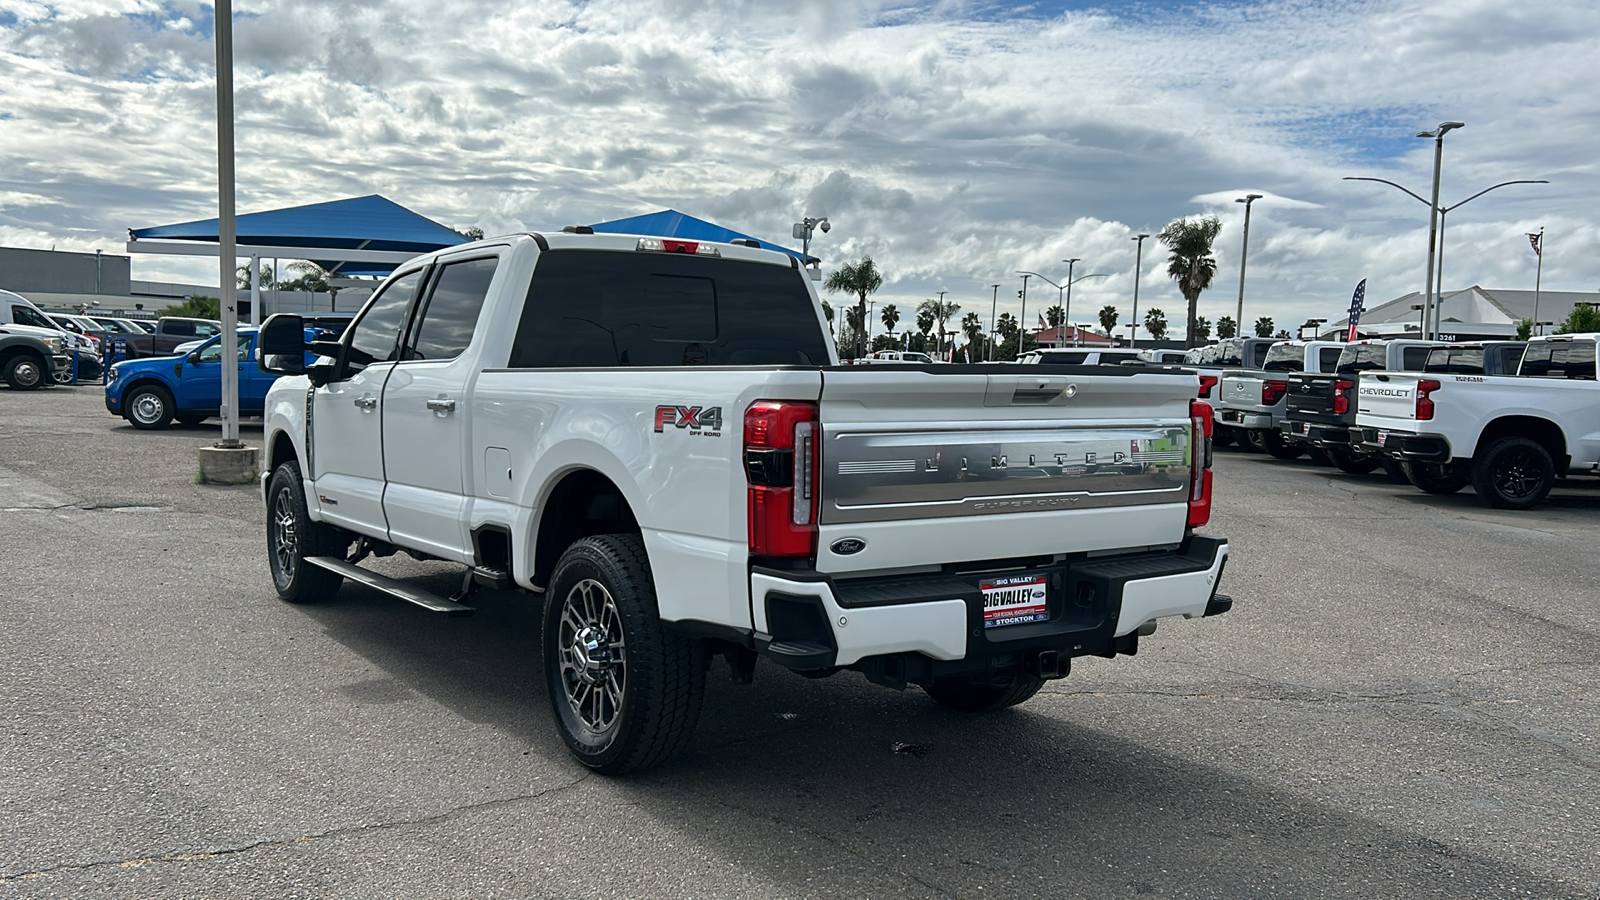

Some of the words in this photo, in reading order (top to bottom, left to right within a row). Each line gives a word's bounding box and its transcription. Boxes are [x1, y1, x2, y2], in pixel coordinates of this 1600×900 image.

[1359, 387, 1410, 397] CHEVROLET
[654, 405, 722, 433] FX4
[925, 451, 1127, 472] LIMITED
[973, 499, 1033, 511] SUPER
[1035, 497, 1080, 507] DUTY
[839, 541, 859, 551] Ford
[1010, 576, 1033, 584] VALLEY
[983, 588, 1033, 607] BIGVALLEY
[995, 616, 1034, 625] STOCKTON
